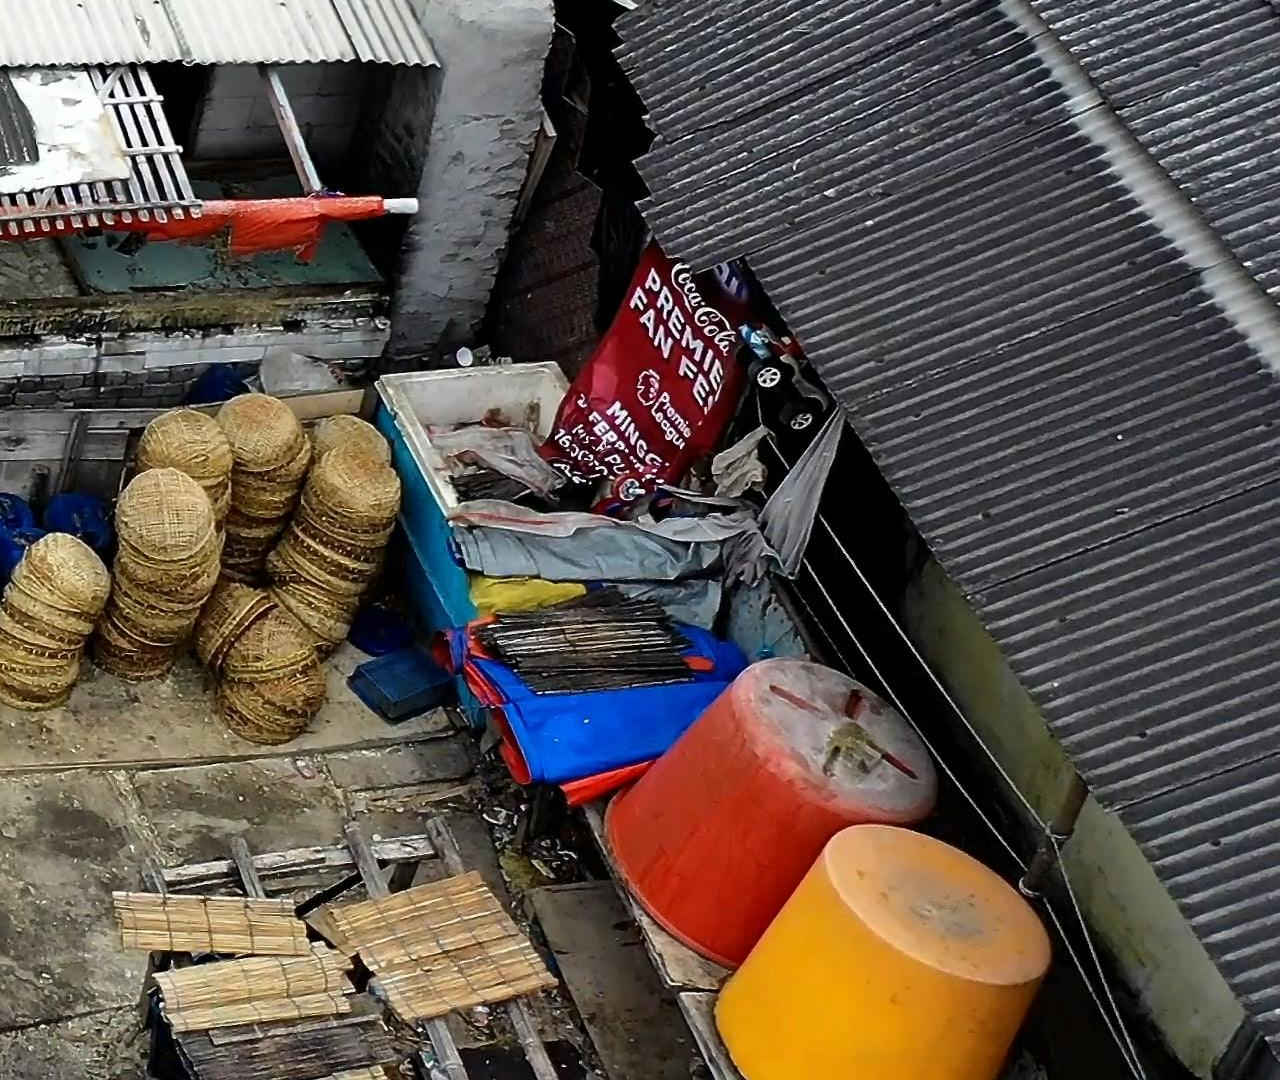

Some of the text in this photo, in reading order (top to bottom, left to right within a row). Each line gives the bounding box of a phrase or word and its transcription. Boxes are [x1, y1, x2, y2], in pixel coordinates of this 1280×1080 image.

[629, 286, 673, 359] FAN
[645, 267, 724, 402] PREMIE
[651, 400, 686, 450] Leagu
